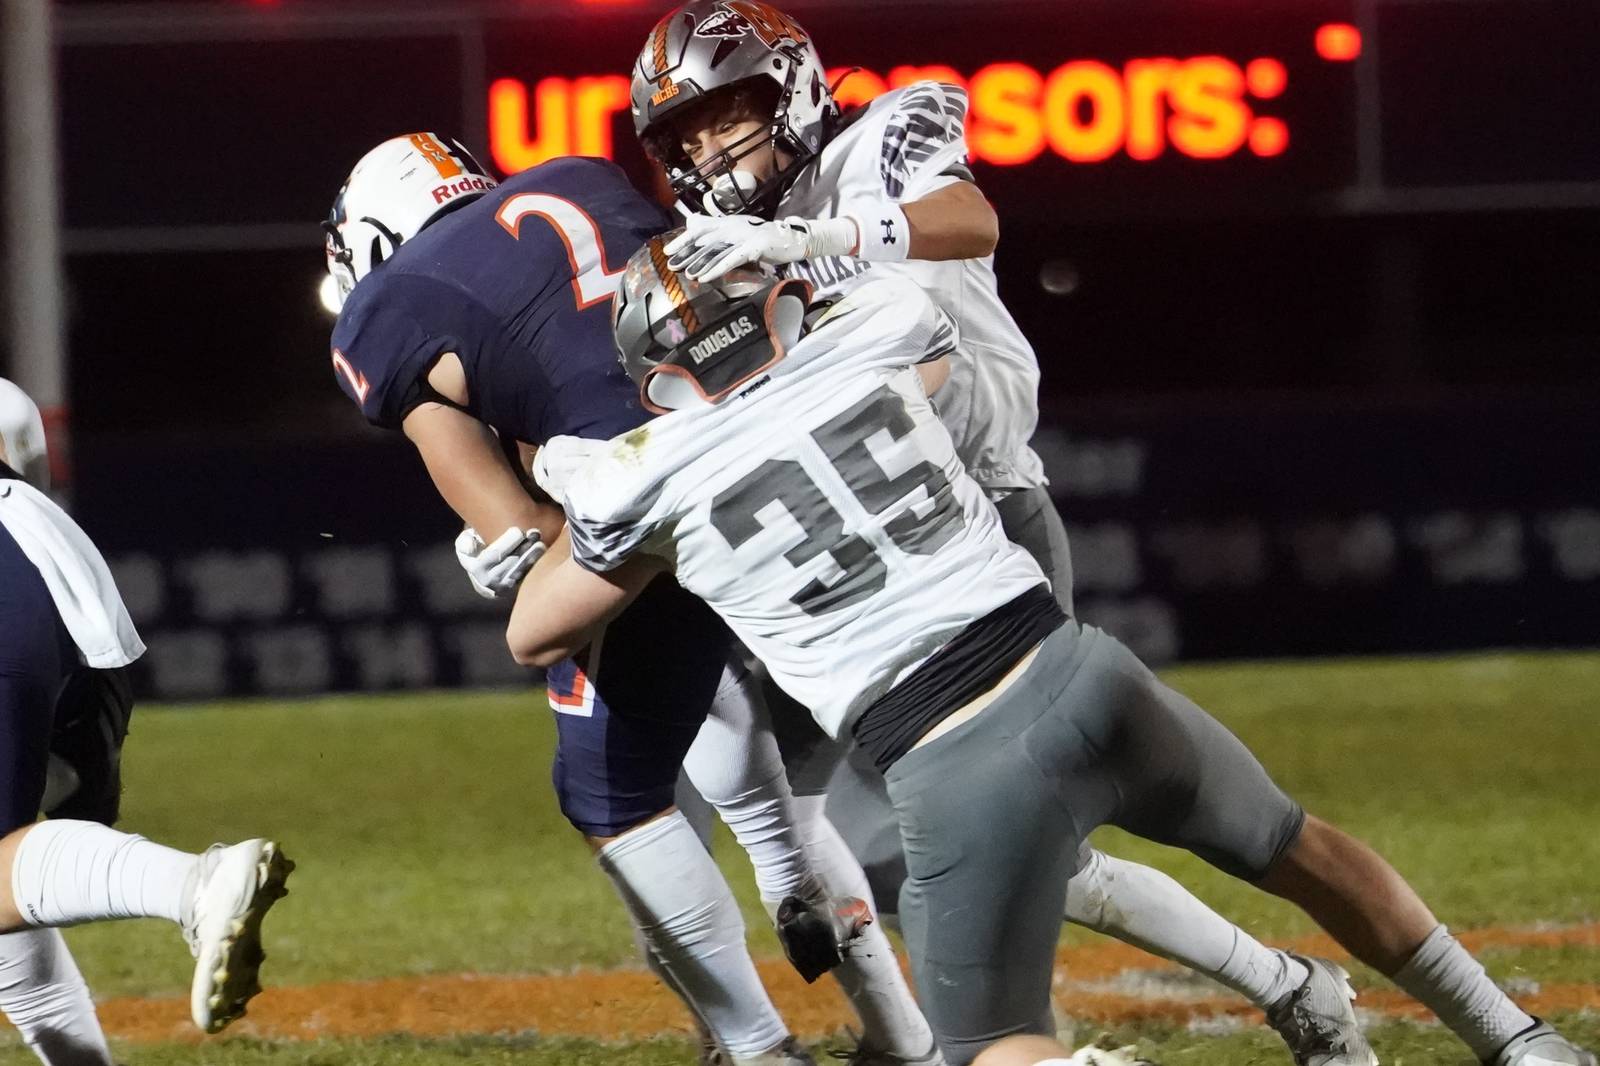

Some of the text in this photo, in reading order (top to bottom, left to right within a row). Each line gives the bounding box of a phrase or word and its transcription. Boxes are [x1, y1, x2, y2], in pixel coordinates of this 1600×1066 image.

[651, 84, 680, 106] MCHS
[431, 177, 498, 204] Ridde
[495, 192, 627, 311] 2
[710, 383, 966, 617] 35
